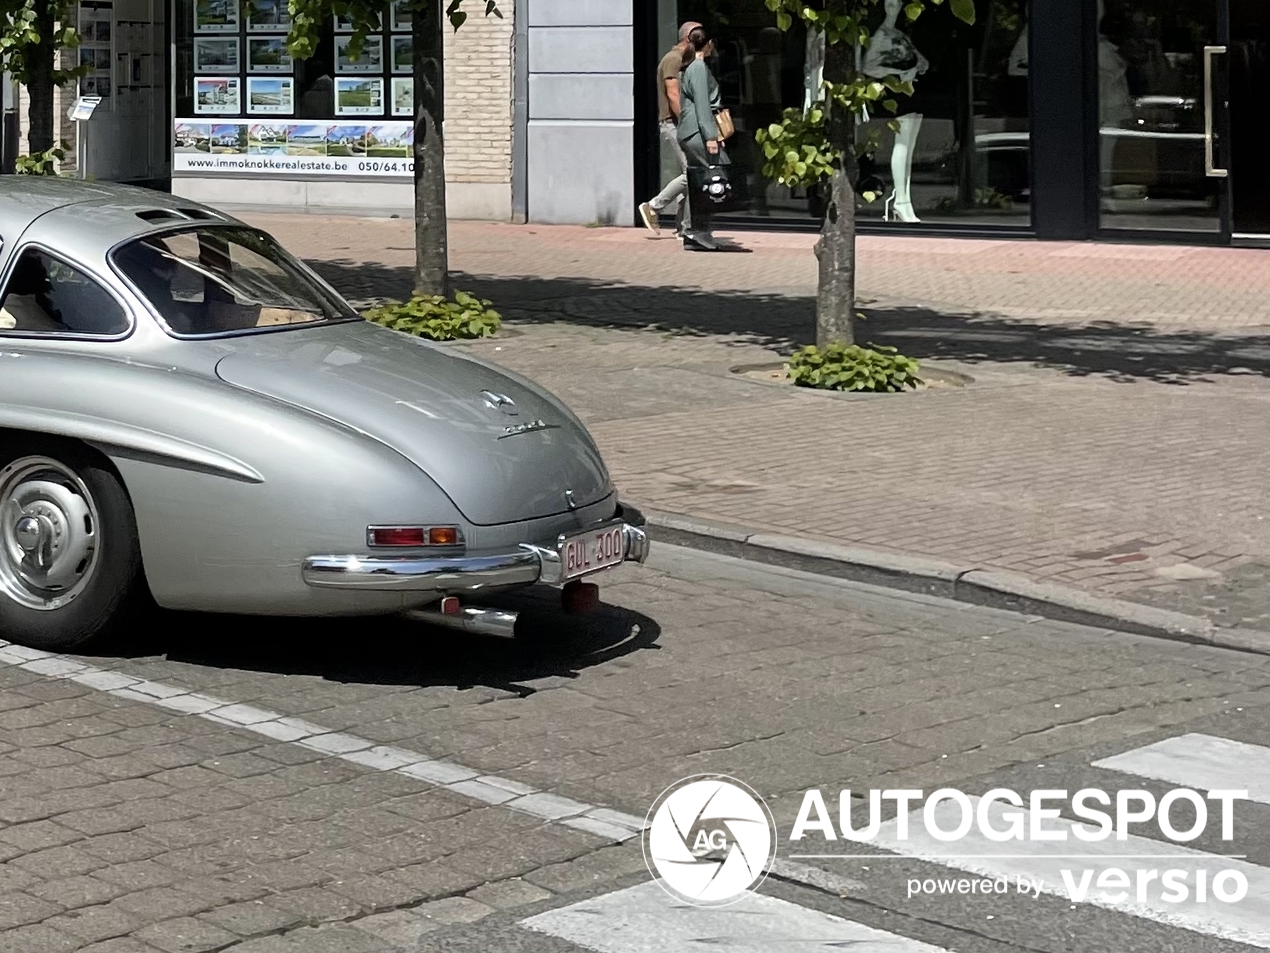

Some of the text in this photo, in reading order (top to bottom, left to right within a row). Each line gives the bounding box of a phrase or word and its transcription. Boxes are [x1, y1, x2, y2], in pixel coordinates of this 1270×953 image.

[187, 158, 415, 172] www.immoknokkerealestate.be 050/64.10
[567, 529, 622, 569] GUL 300
